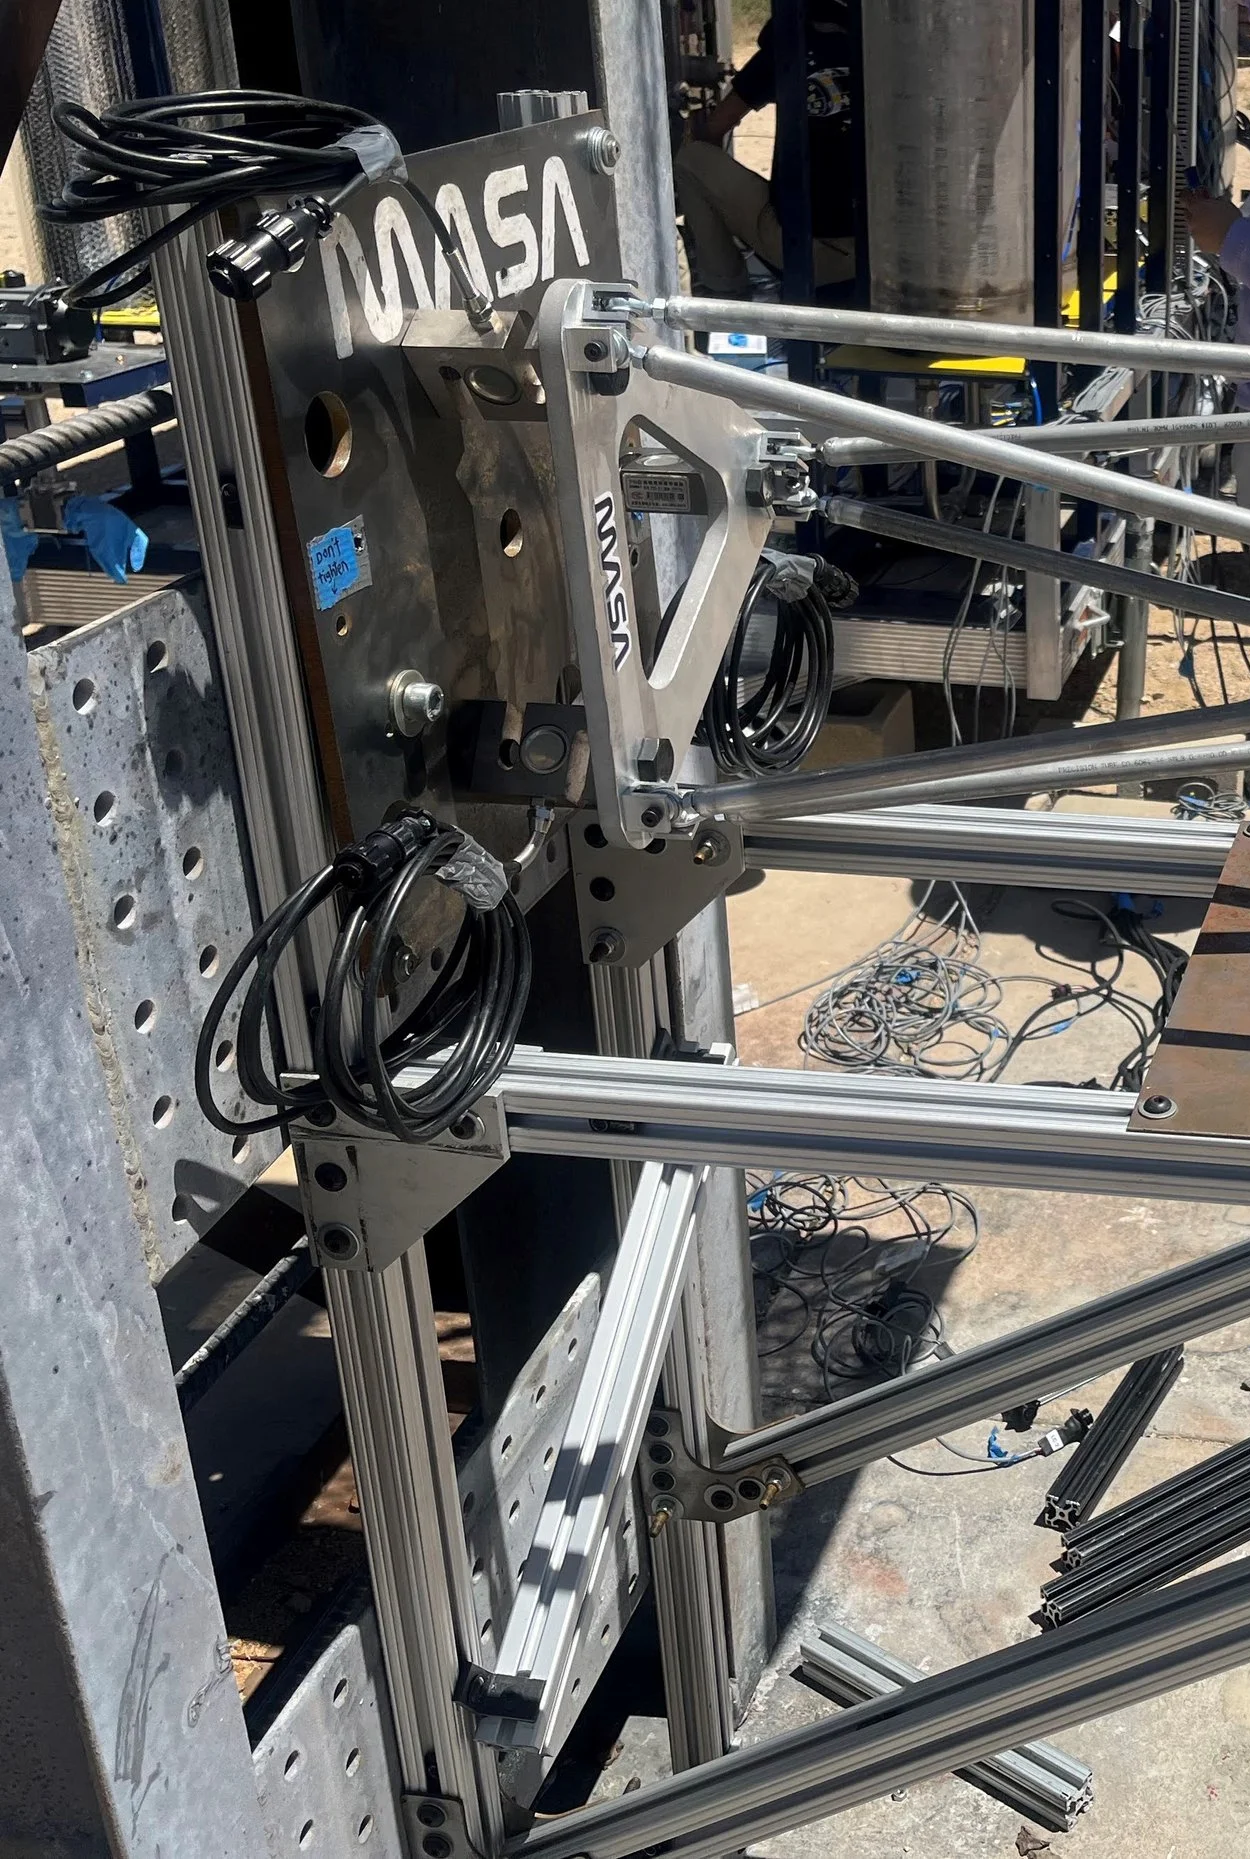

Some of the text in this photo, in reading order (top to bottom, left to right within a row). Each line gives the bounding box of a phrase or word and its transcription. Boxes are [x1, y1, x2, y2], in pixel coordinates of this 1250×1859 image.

[316, 537, 341, 564] Don't
[318, 560, 349, 584] tighten
[595, 496, 630, 672] MASA
